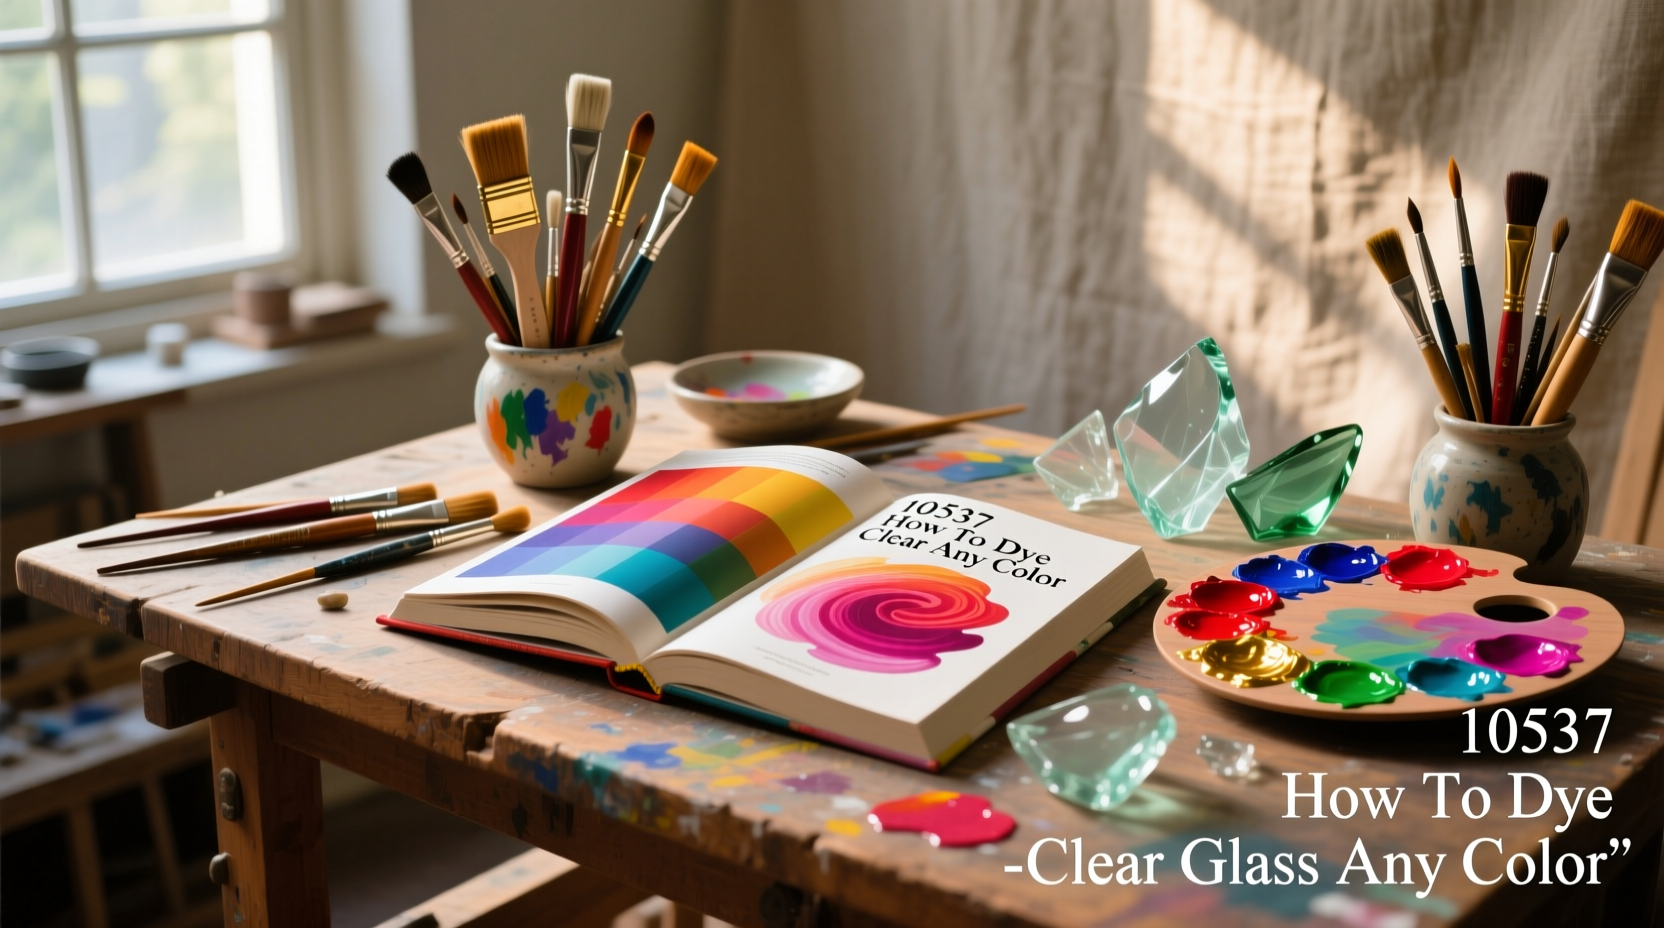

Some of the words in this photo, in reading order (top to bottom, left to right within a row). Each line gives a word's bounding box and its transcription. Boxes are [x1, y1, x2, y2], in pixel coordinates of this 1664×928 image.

[881, 514, 949, 535] How
[952, 528, 987, 547] To
[993, 537, 1052, 565] Dye
[901, 500, 995, 528] 10537
[858, 528, 929, 551] Clear
[930, 541, 988, 568] Any
[991, 558, 1067, 588] Color
